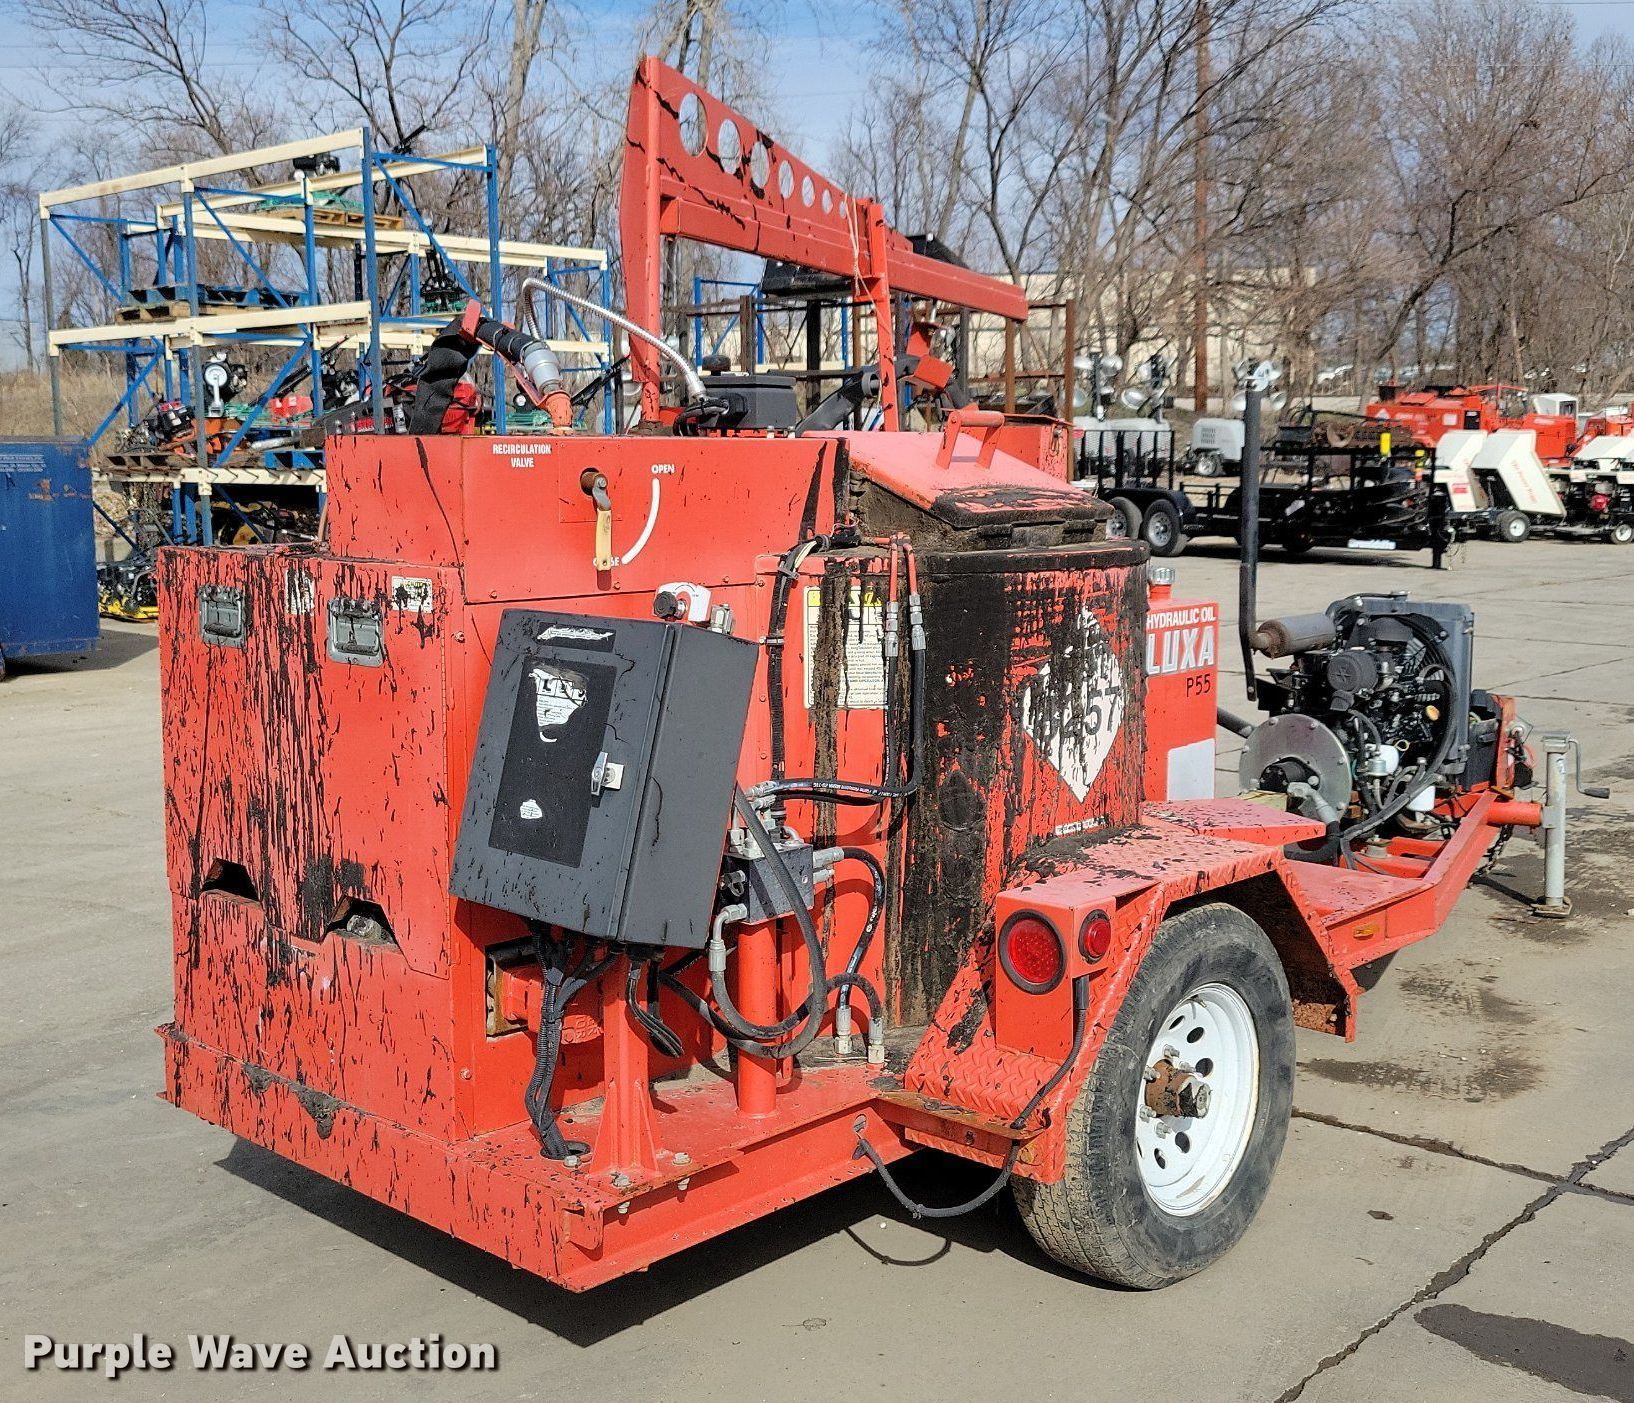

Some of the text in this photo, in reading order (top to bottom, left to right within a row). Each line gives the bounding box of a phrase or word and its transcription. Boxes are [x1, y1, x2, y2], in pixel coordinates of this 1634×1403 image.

[492, 444, 552, 455] RECIRCULATION
[511, 457, 535, 468] VALVE
[651, 464, 675, 474] OPEN
[592, 556, 620, 567] CSE
[1147, 606, 1216, 629] HYDRAULIC OIL
[1146, 625, 1215, 676] LUXA
[1186, 673, 1211, 698] P55
